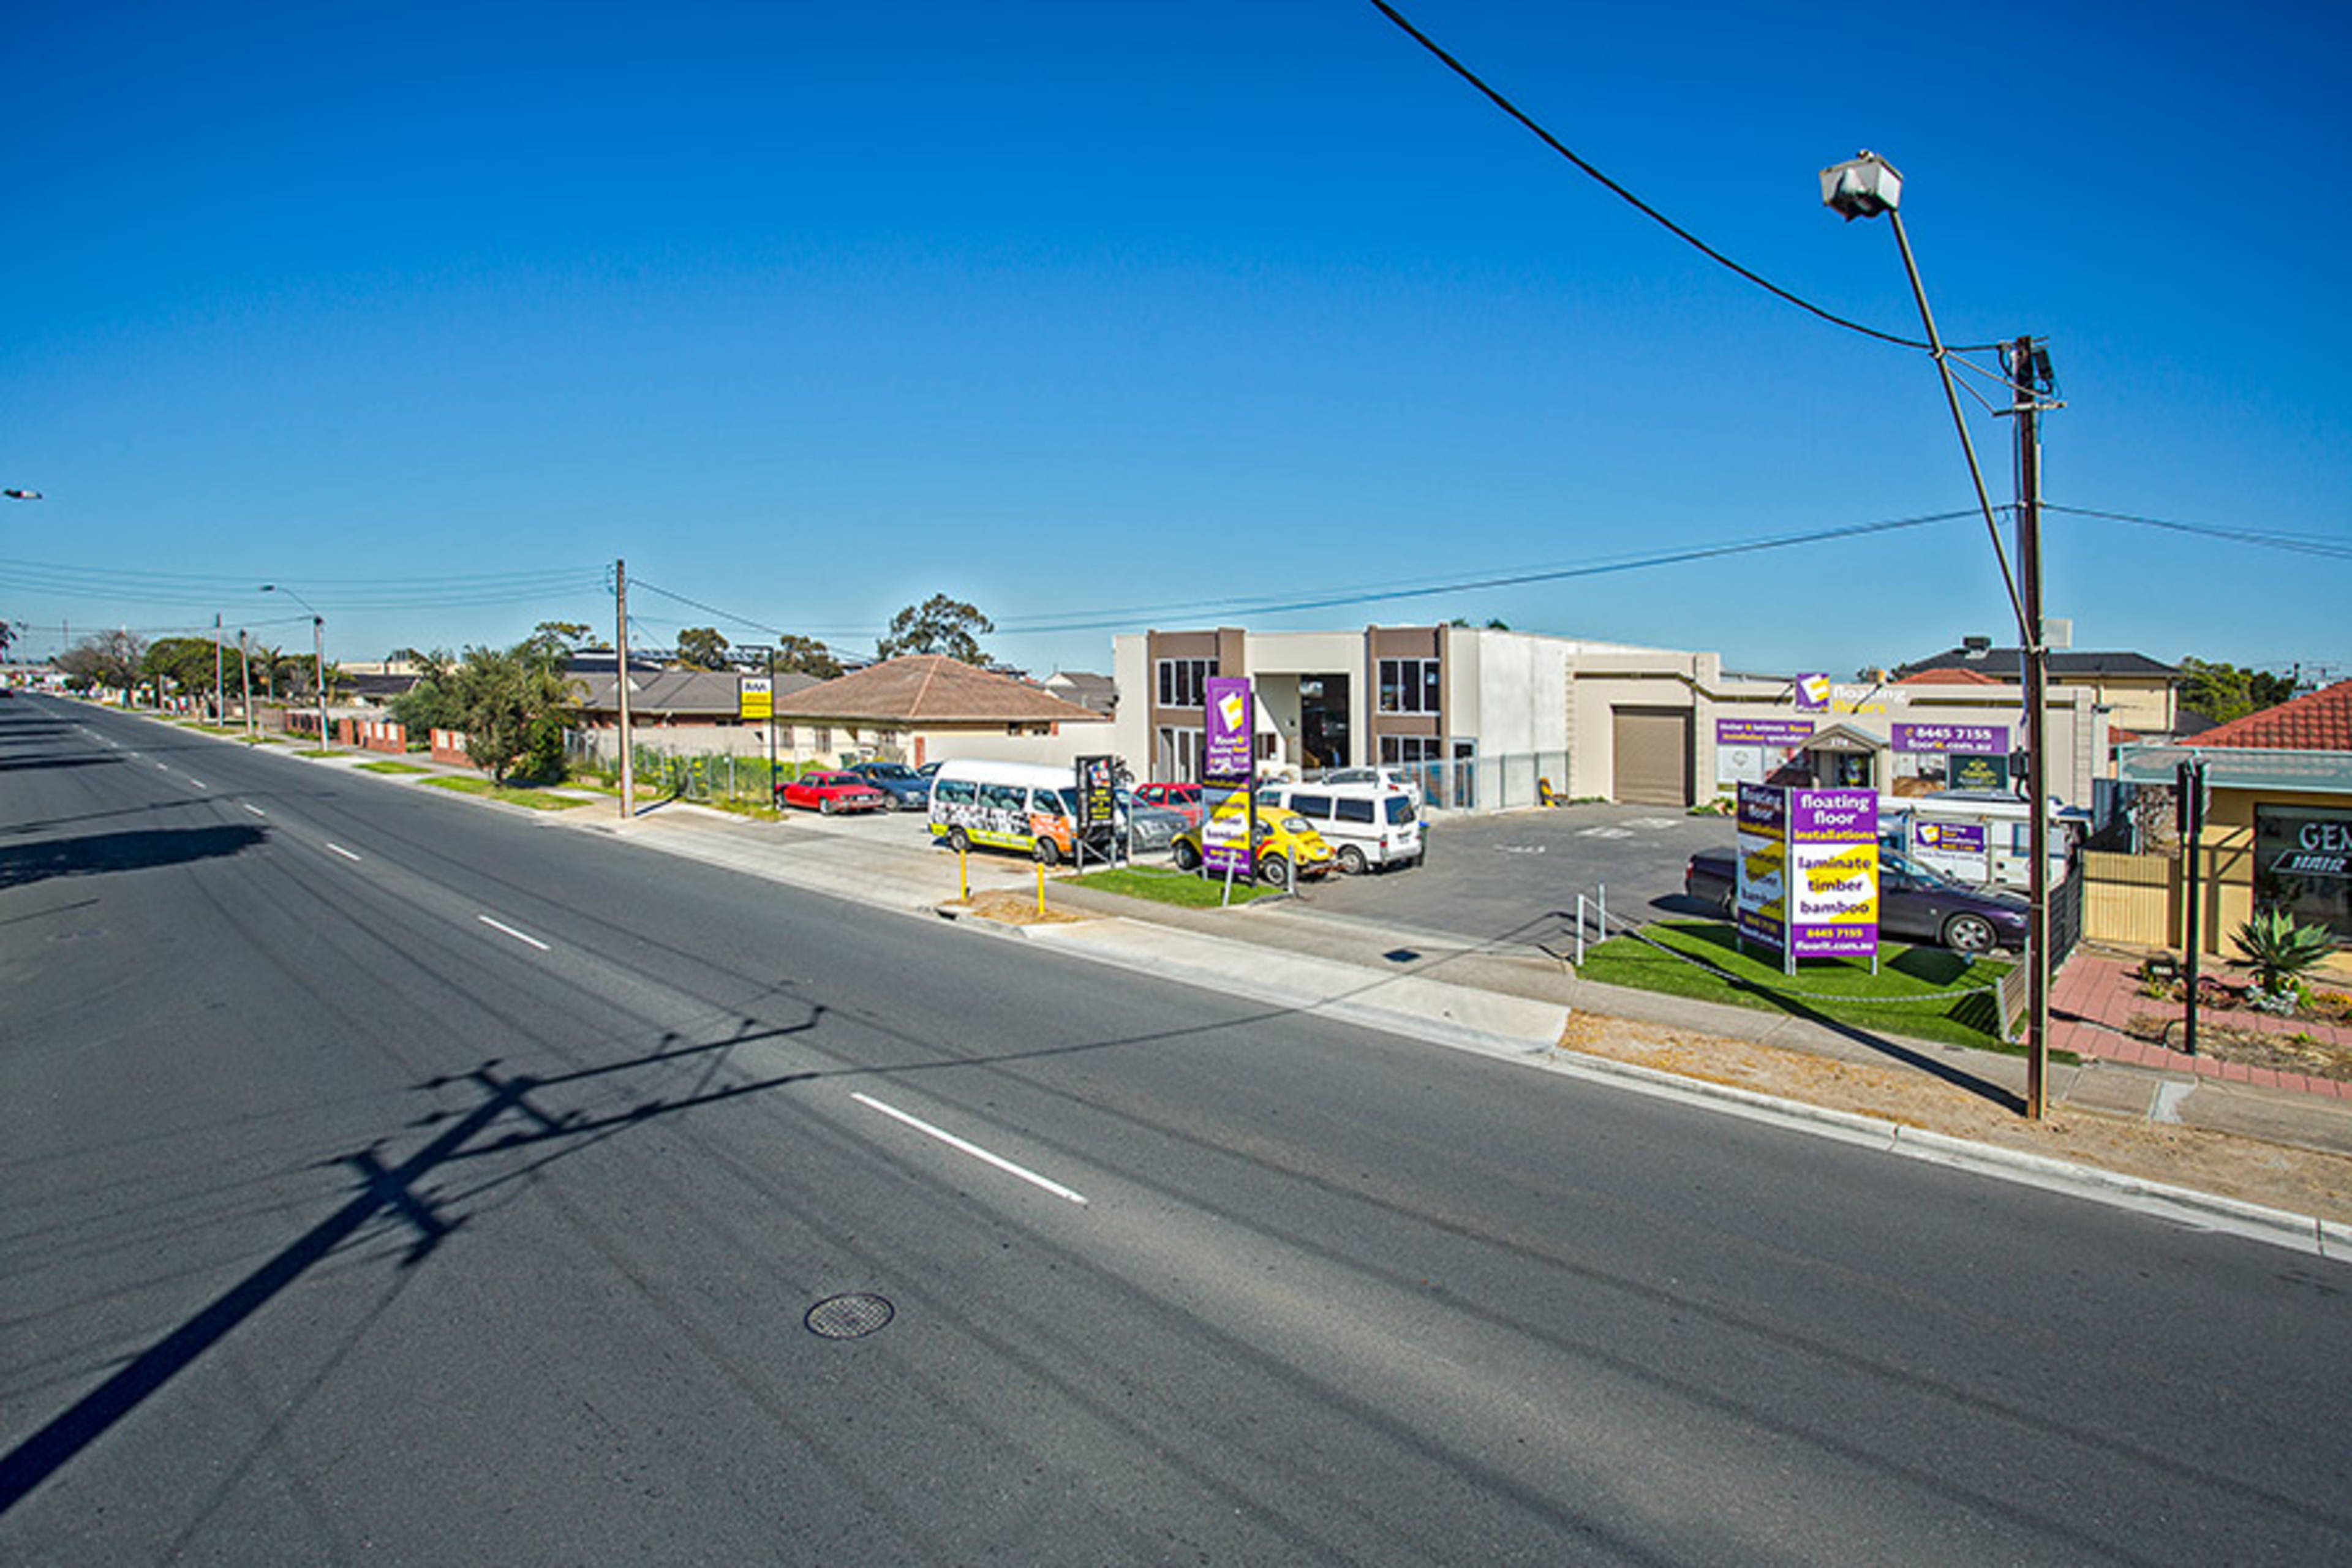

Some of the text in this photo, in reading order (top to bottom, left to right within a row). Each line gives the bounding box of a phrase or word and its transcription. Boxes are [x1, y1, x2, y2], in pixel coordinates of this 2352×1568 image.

[1917, 727, 1992, 740] 8445 7155
[1801, 794, 1869, 813] floating
[1814, 810, 1856, 824] floor
[1795, 829, 1875, 840] installations
[1798, 856, 1871, 869] laminate
[1808, 878, 1863, 891] timber
[1800, 900, 1869, 913] bamboo
[1806, 928, 1863, 938] 8445 7155
